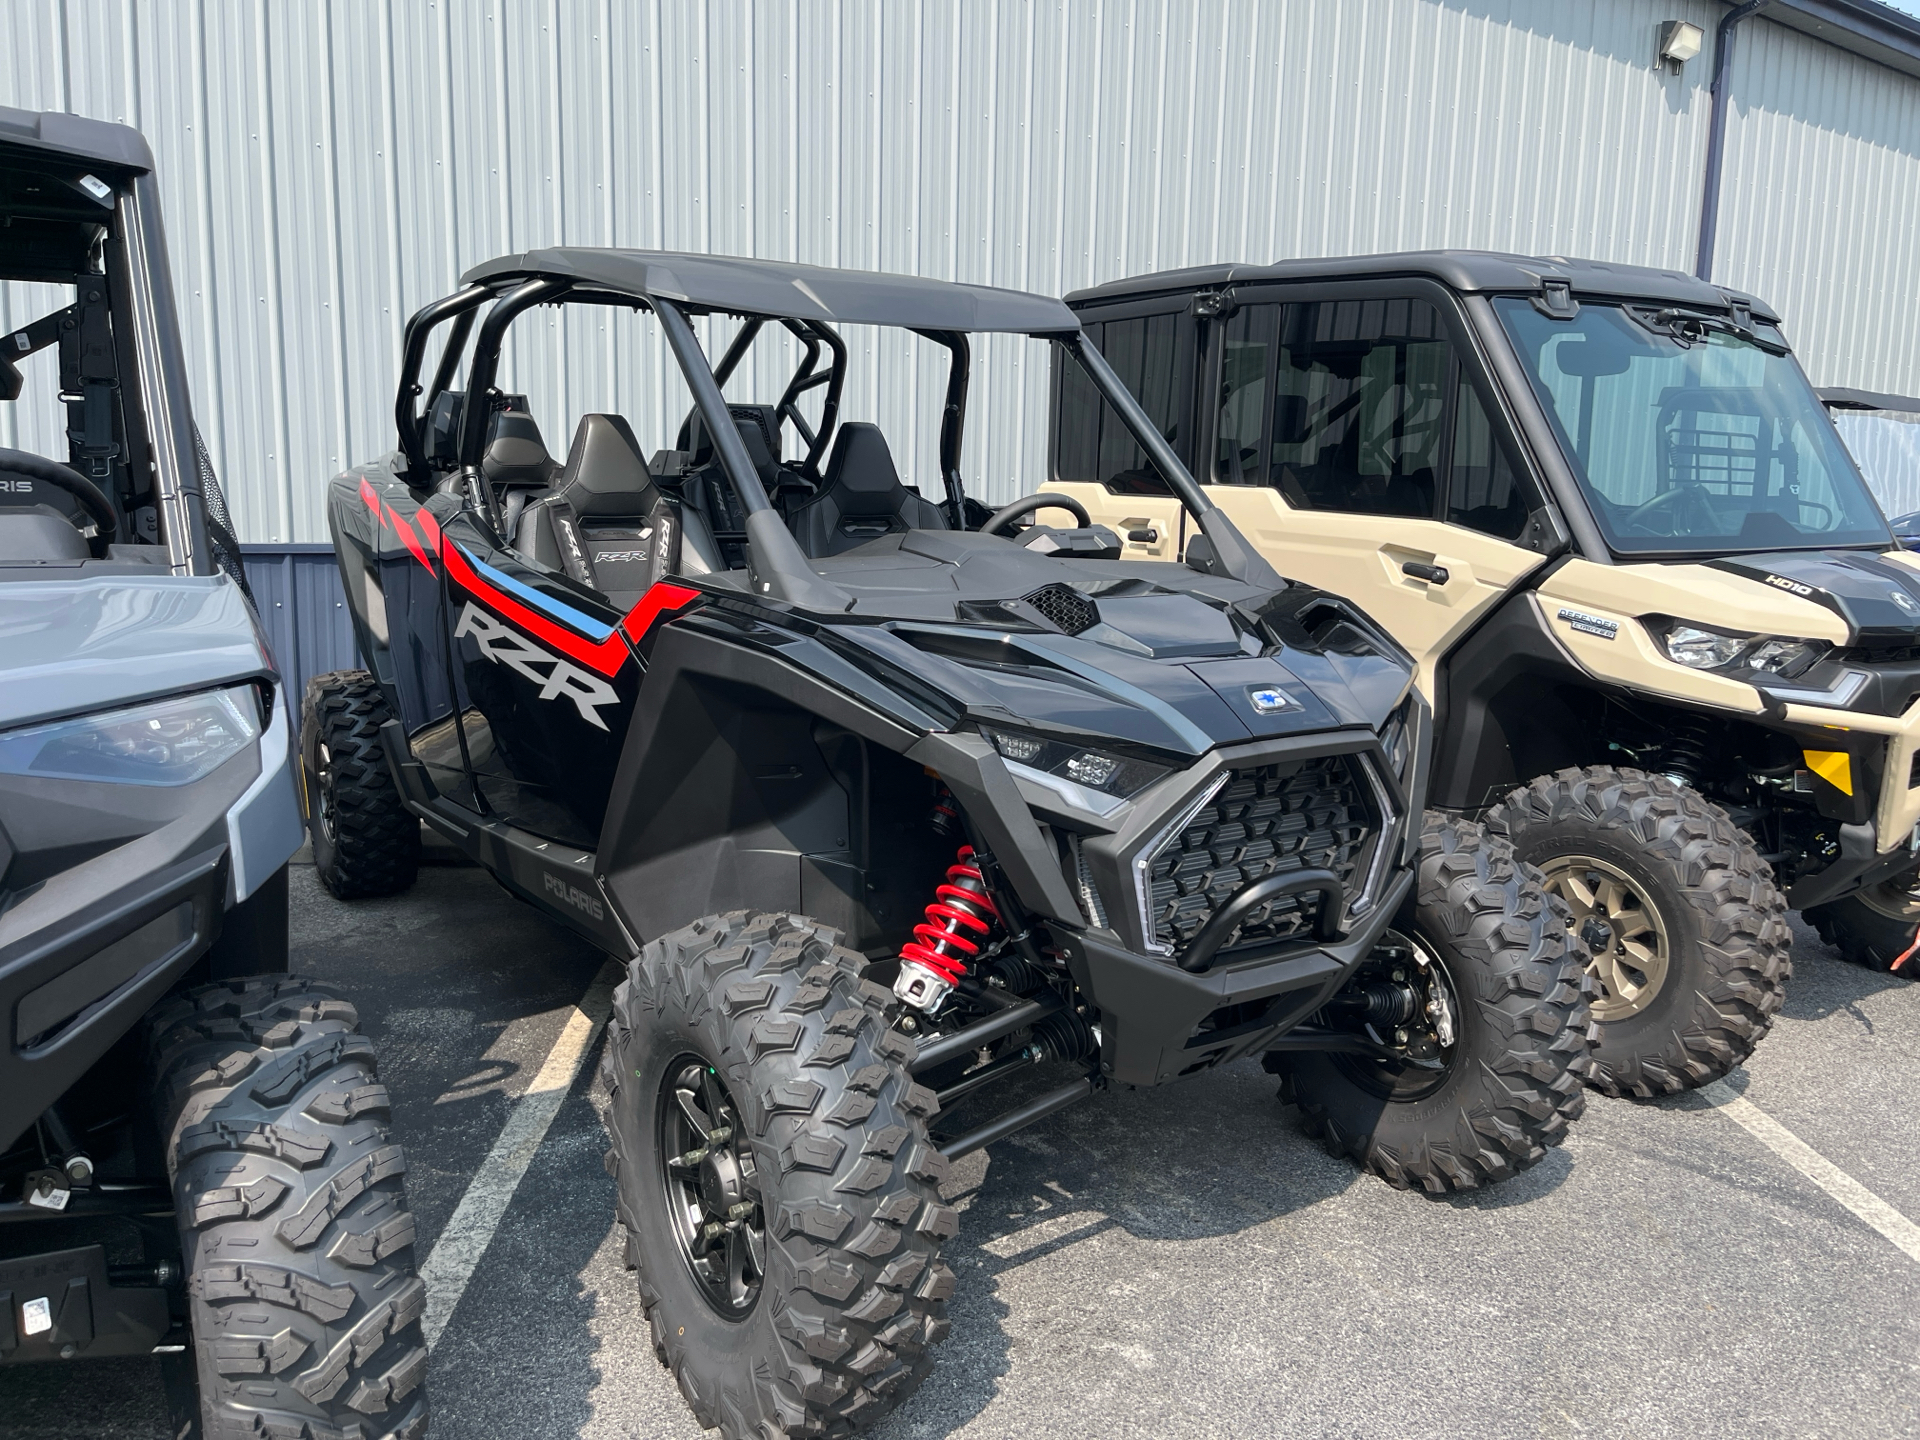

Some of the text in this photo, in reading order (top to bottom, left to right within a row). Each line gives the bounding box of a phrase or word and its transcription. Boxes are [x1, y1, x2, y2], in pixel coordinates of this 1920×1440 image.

[560, 519, 582, 558] RZR
[594, 550, 648, 563] RZR
[659, 518, 671, 558] RZR
[1765, 574, 1813, 595] HD10
[1559, 608, 1618, 631] DEFENDER
[454, 600, 621, 733] RZR
[543, 871, 605, 920] POLARIS
